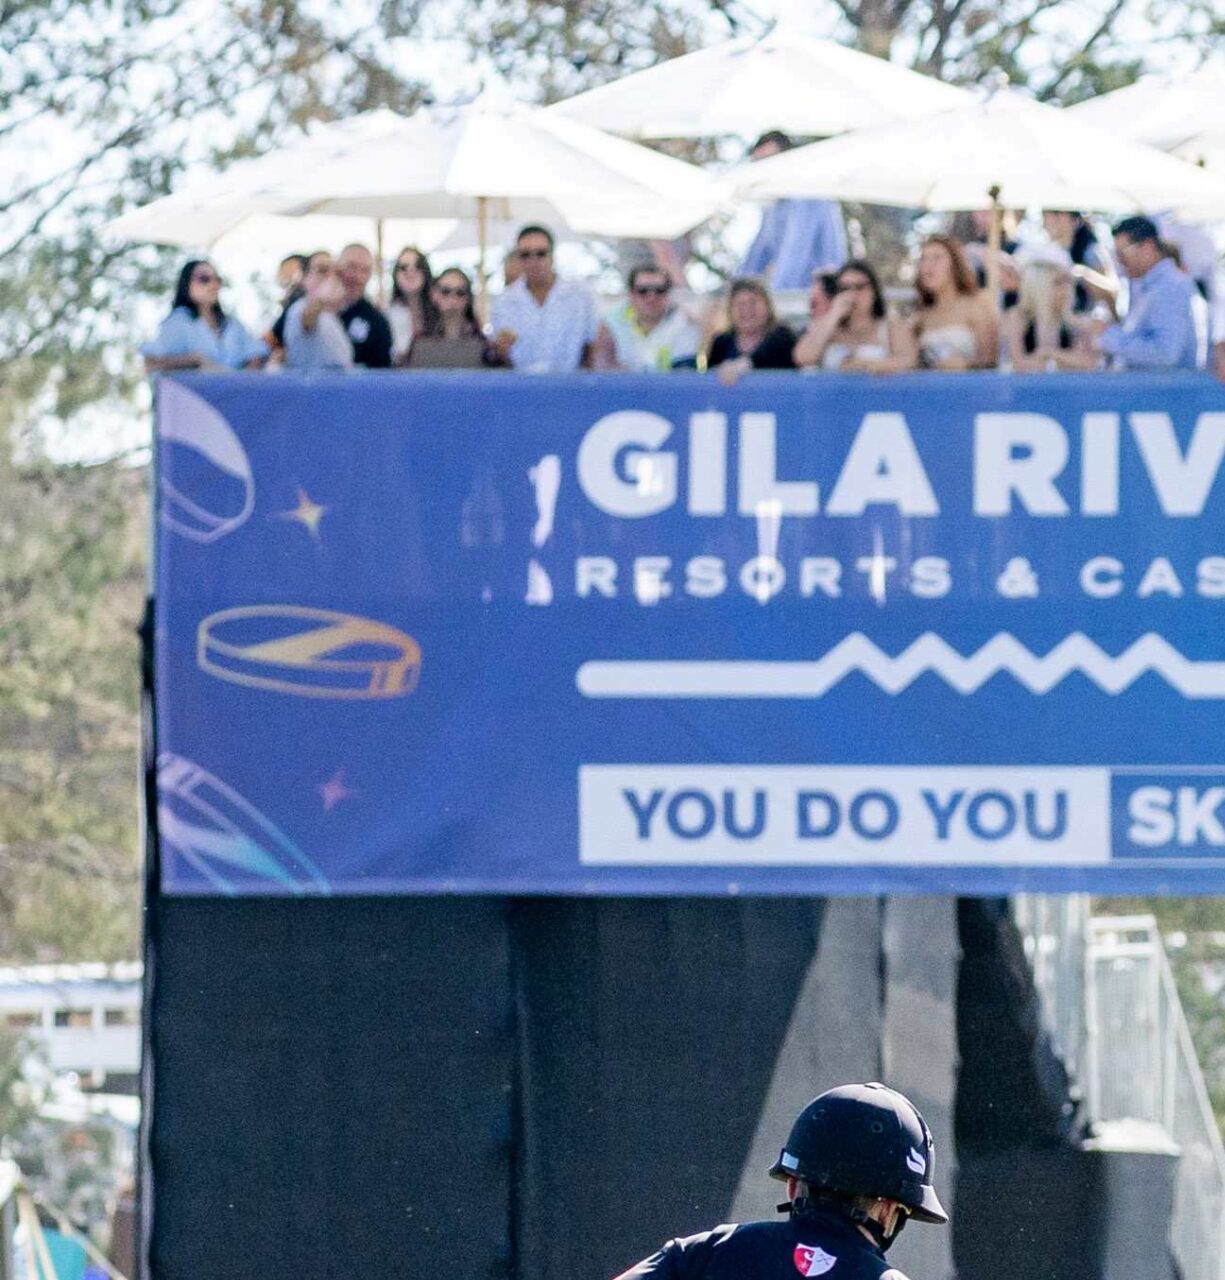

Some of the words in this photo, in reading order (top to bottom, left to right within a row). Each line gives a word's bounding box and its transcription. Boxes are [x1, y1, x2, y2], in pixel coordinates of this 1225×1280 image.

[577, 410, 940, 518] GILA
[576, 555, 951, 599] RESORTS
[996, 556, 1039, 598] &
[621, 787, 768, 843] YOU
[795, 787, 901, 843] DO
[920, 787, 1069, 843] YOU
